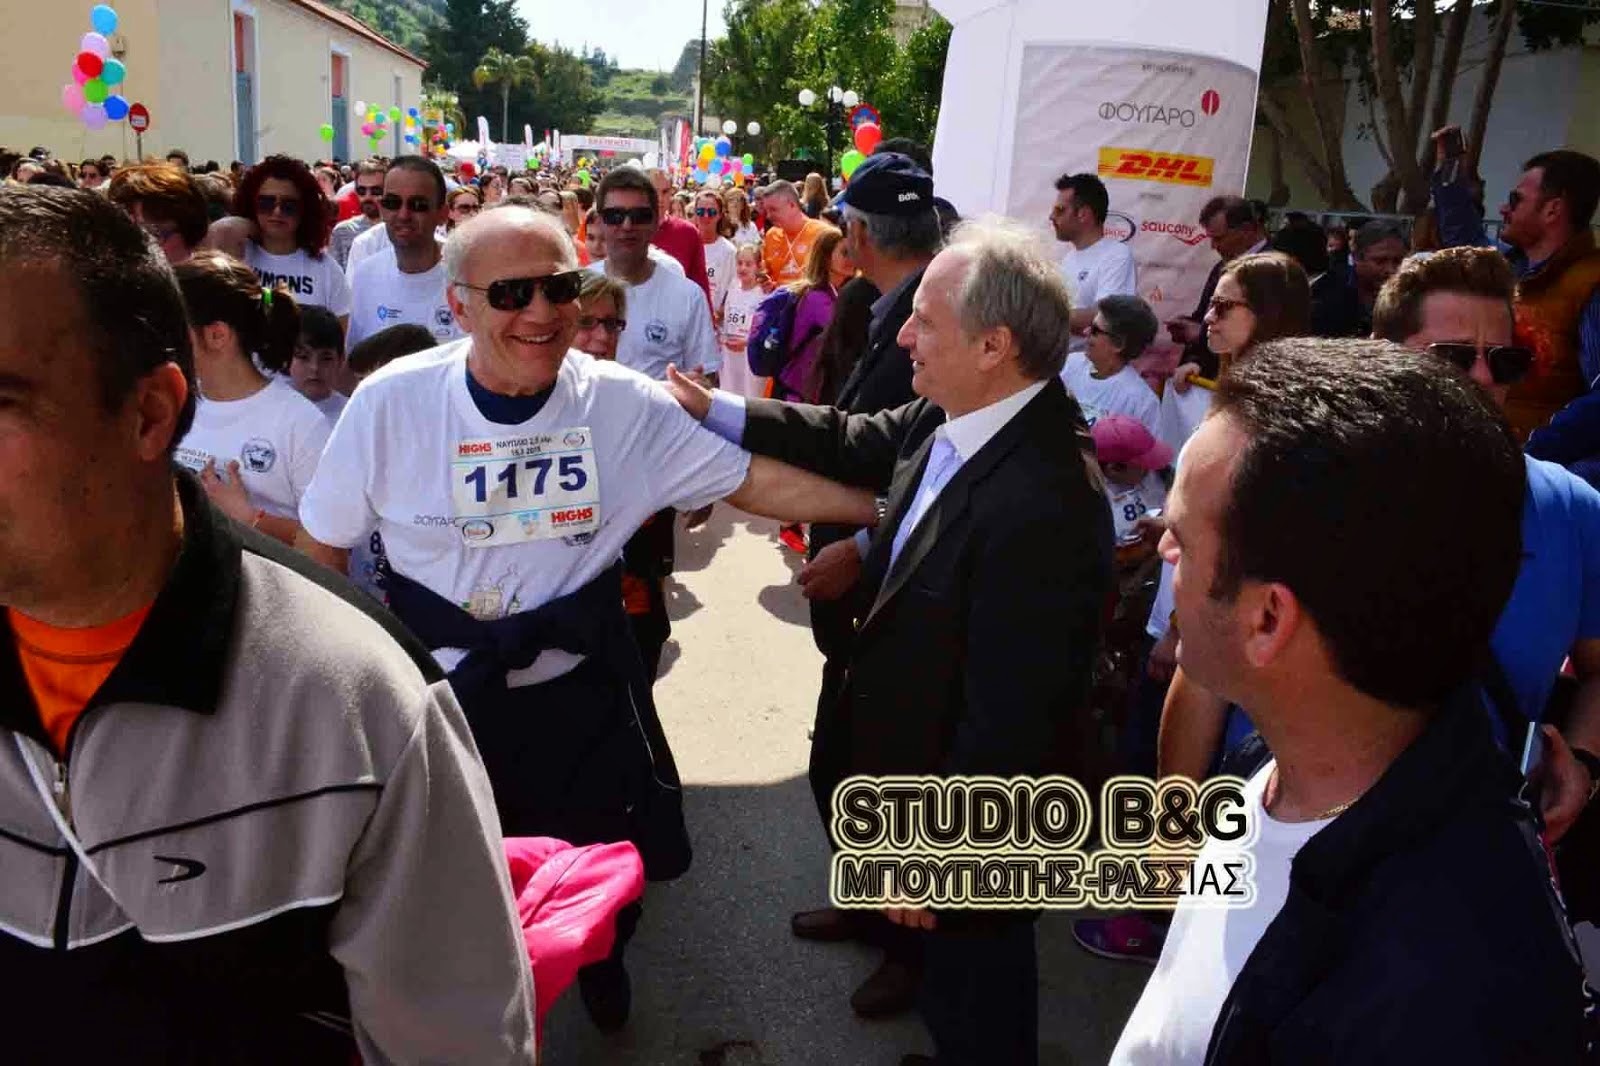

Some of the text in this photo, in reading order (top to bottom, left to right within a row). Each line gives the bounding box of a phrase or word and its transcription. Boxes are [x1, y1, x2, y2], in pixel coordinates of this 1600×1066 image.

[1098, 102, 1195, 128] ΦΟΥΓΑΡΟ
[1117, 153, 1203, 181] DHL
[1140, 221, 1195, 237] saucony
[464, 455, 588, 503] 1175
